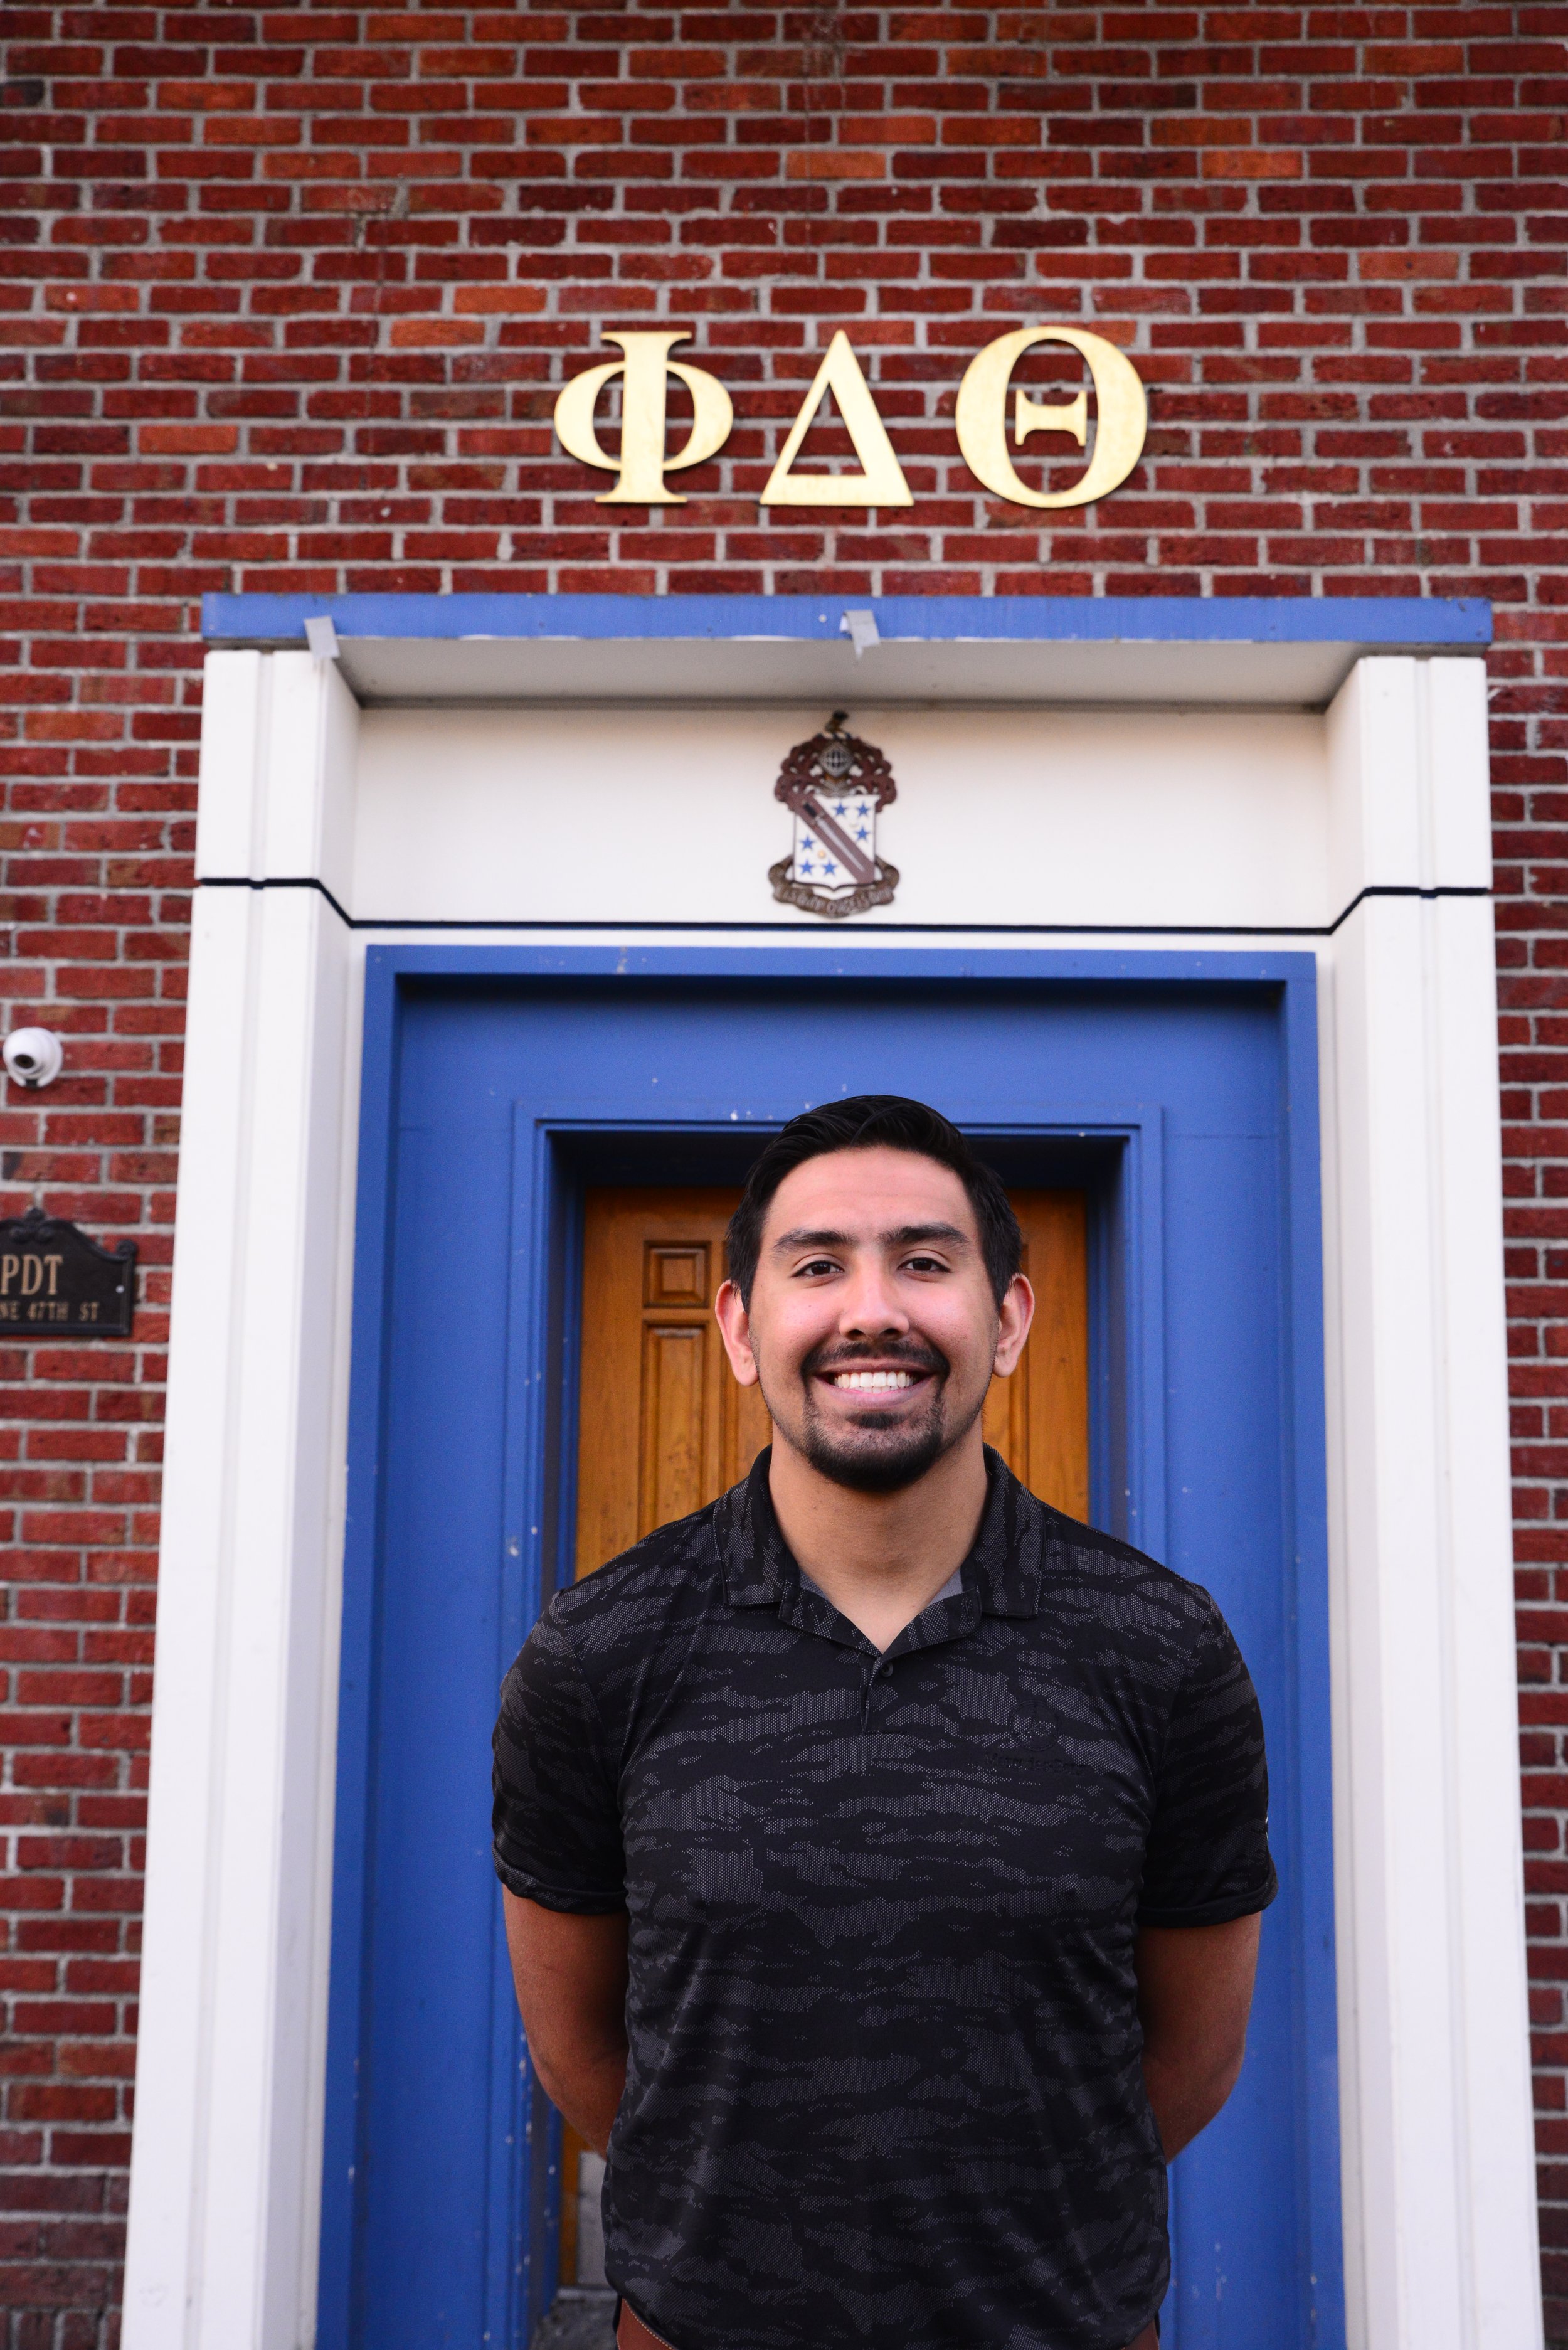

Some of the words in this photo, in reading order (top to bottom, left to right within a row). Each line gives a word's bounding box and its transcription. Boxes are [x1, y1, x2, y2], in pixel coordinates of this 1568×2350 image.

[0, 1254, 63, 1295] PDT
[27, 1301, 69, 1321] 47TH
[79, 1301, 100, 1321] ST
